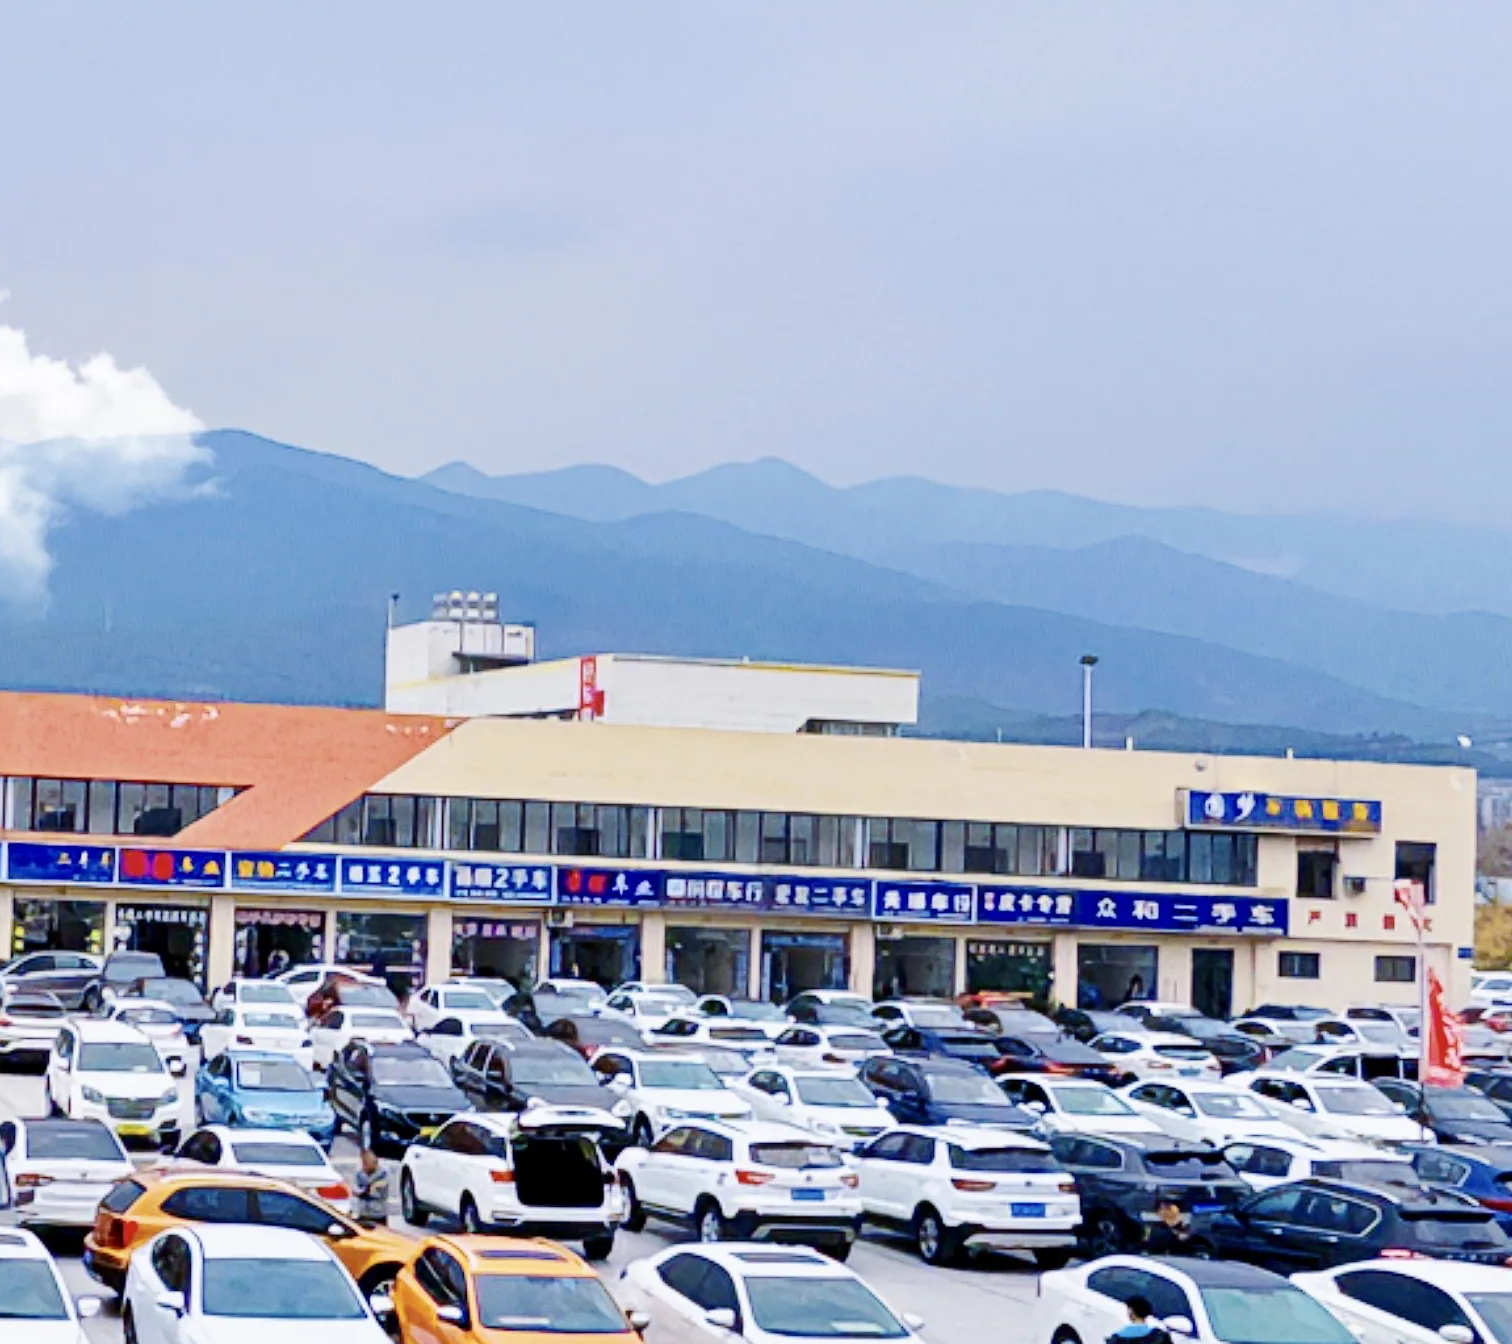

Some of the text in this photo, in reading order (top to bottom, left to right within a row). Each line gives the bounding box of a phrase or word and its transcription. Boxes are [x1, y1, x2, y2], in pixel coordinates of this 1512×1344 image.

[1096, 897, 1276, 926] 众和二手车
